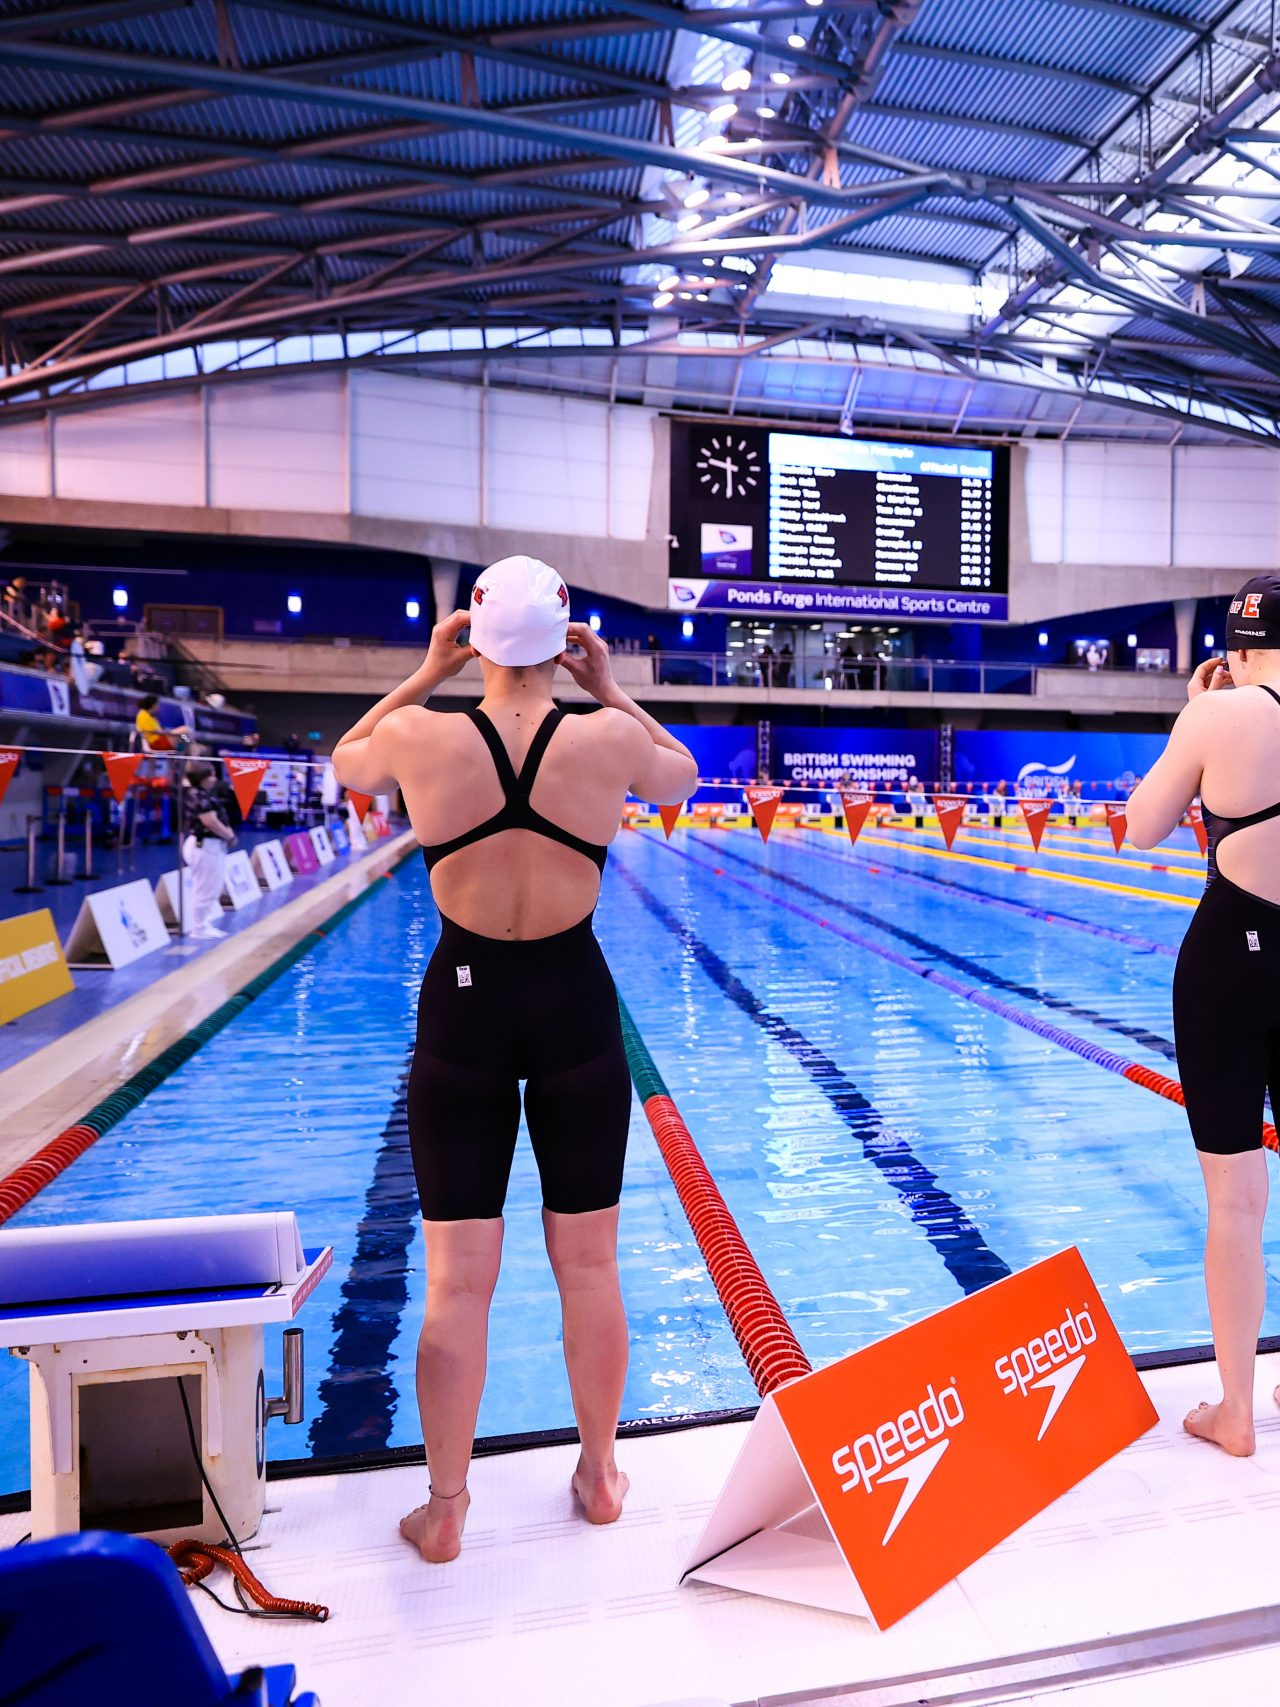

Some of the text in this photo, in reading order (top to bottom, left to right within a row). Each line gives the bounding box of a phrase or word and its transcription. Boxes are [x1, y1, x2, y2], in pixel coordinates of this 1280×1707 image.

[727, 587, 991, 614] Ponds Forge International Sports Centre
[1241, 593, 1263, 618] E
[230, 760, 267, 769] speedo
[784, 752, 916, 767] BRITISH SWIMMING
[792, 767, 908, 781] CHAMPONSHIPS
[994, 1306, 1097, 1398] speedo
[832, 1384, 965, 1494] speedo
